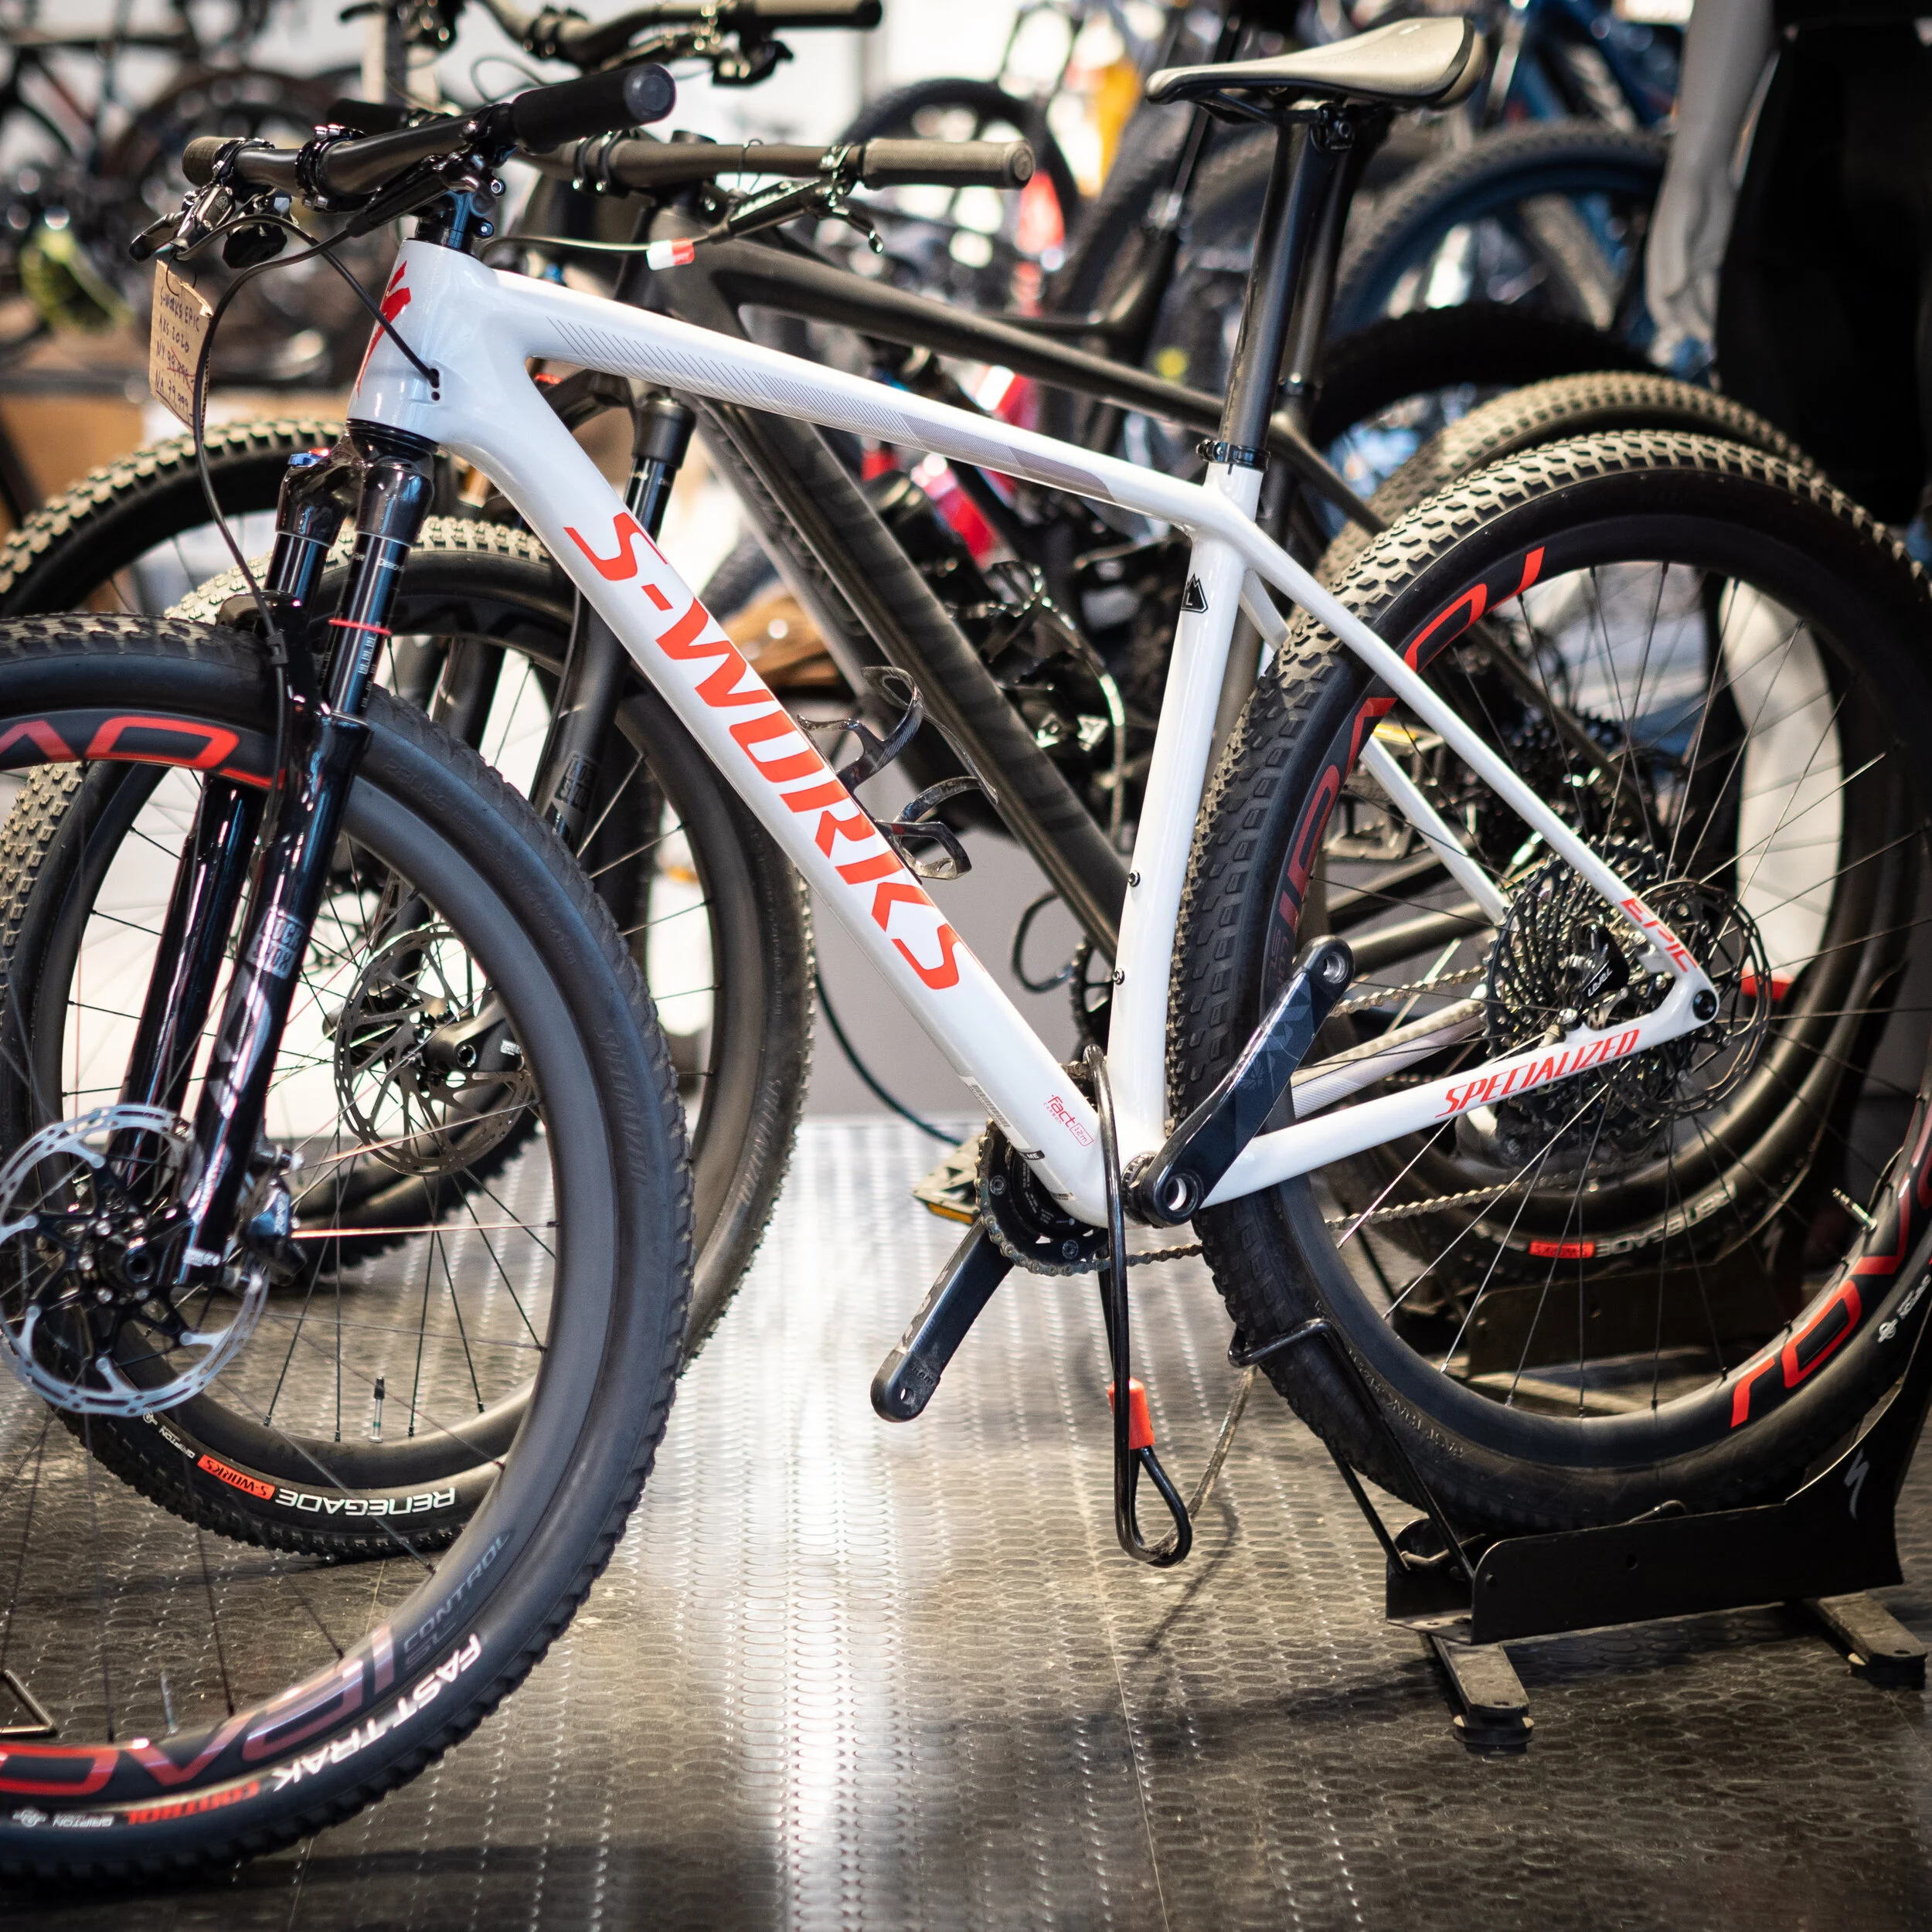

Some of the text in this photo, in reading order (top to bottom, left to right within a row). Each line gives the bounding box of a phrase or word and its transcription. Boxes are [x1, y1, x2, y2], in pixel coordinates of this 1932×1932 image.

[172, 326, 189, 353] 2020
[1185, 592, 1193, 607] L
[564, 512, 983, 990] S-WORKS
[1621, 897, 1699, 973] EPIC
[1435, 1029, 1640, 1118] SPECIALIZED
[1597, 1179, 1737, 1258] RENEGADE
[159, 1429, 196, 1460] GRIPTON
[204, 1459, 268, 1498] S-WORKS
[275, 1488, 456, 1516] RENEGADE
[403, 1529, 517, 1652] CONTROL
[393, 1633, 482, 1729] FAST
[271, 1717, 386, 1793] TRAK
[52, 1813, 114, 1828] GRIPTON
